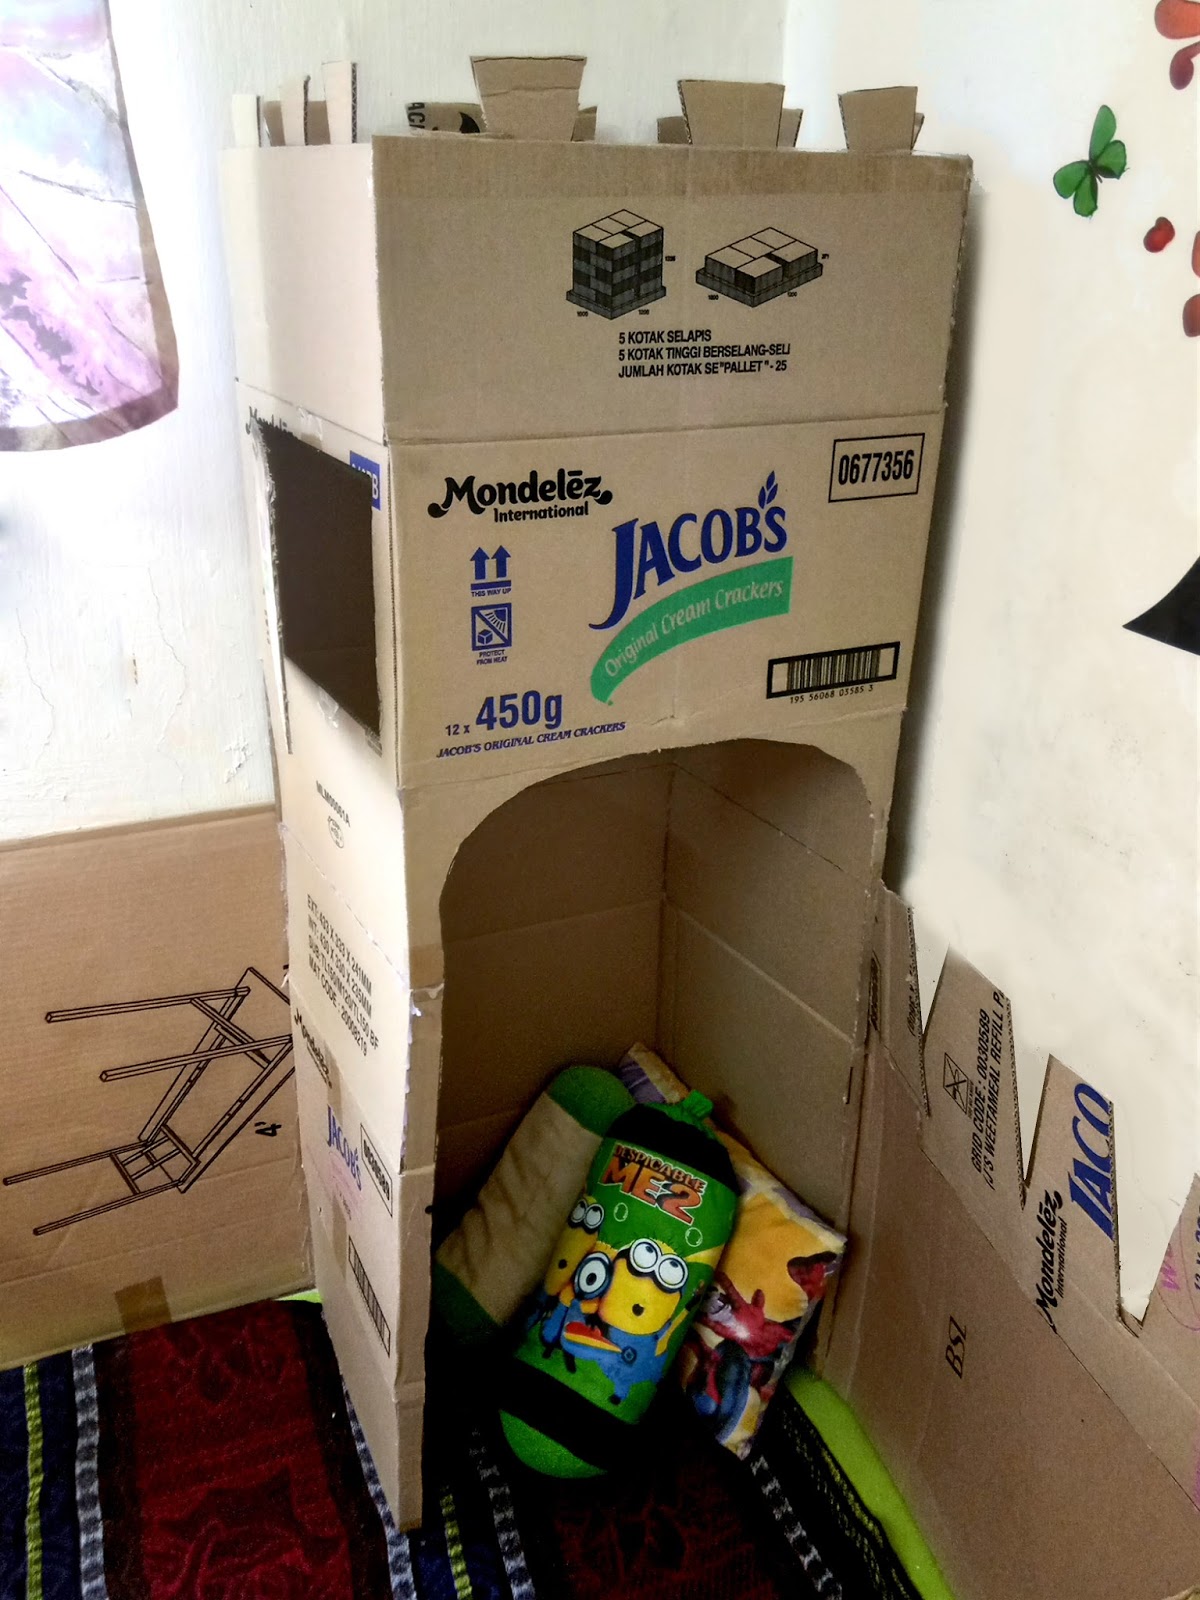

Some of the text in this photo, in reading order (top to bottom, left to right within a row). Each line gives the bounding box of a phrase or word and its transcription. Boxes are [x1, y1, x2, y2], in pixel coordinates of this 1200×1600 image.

[618, 329, 712, 344] 5 KOTAK SELAPIS
[618, 343, 791, 361] 5 KOTAK TINGGI BERSELANG-SELI
[618, 364, 664, 378] JUMLAH
[666, 363, 702, 376] KOTAK
[775, 360, 787, 371] 25
[838, 450, 914, 485] 0677356
[428, 468, 613, 519] Mondelēz
[494, 501, 589, 523] International
[604, 580, 783, 677] Original Cream Crackers
[479, 649, 505, 657] PROTECT
[809, 690, 835, 701] 56068
[868, 684, 874, 692] 3
[445, 690, 563, 736] 12 x 450g
[436, 721, 626, 758] JACOB'S ORIGINAL CREAM CRACKERS
[320, 973, 337, 1008] CODE
[977, 1008, 990, 1081] 0030589
[990, 1010, 1004, 1060] REFILL
[973, 1090, 986, 1134] CODE
[984, 1065, 1002, 1158] WEETAMEAL
[613, 1143, 707, 1194] DESPICABLE
[971, 1133, 983, 1173] GRID
[1056, 1217, 1068, 1299] International
